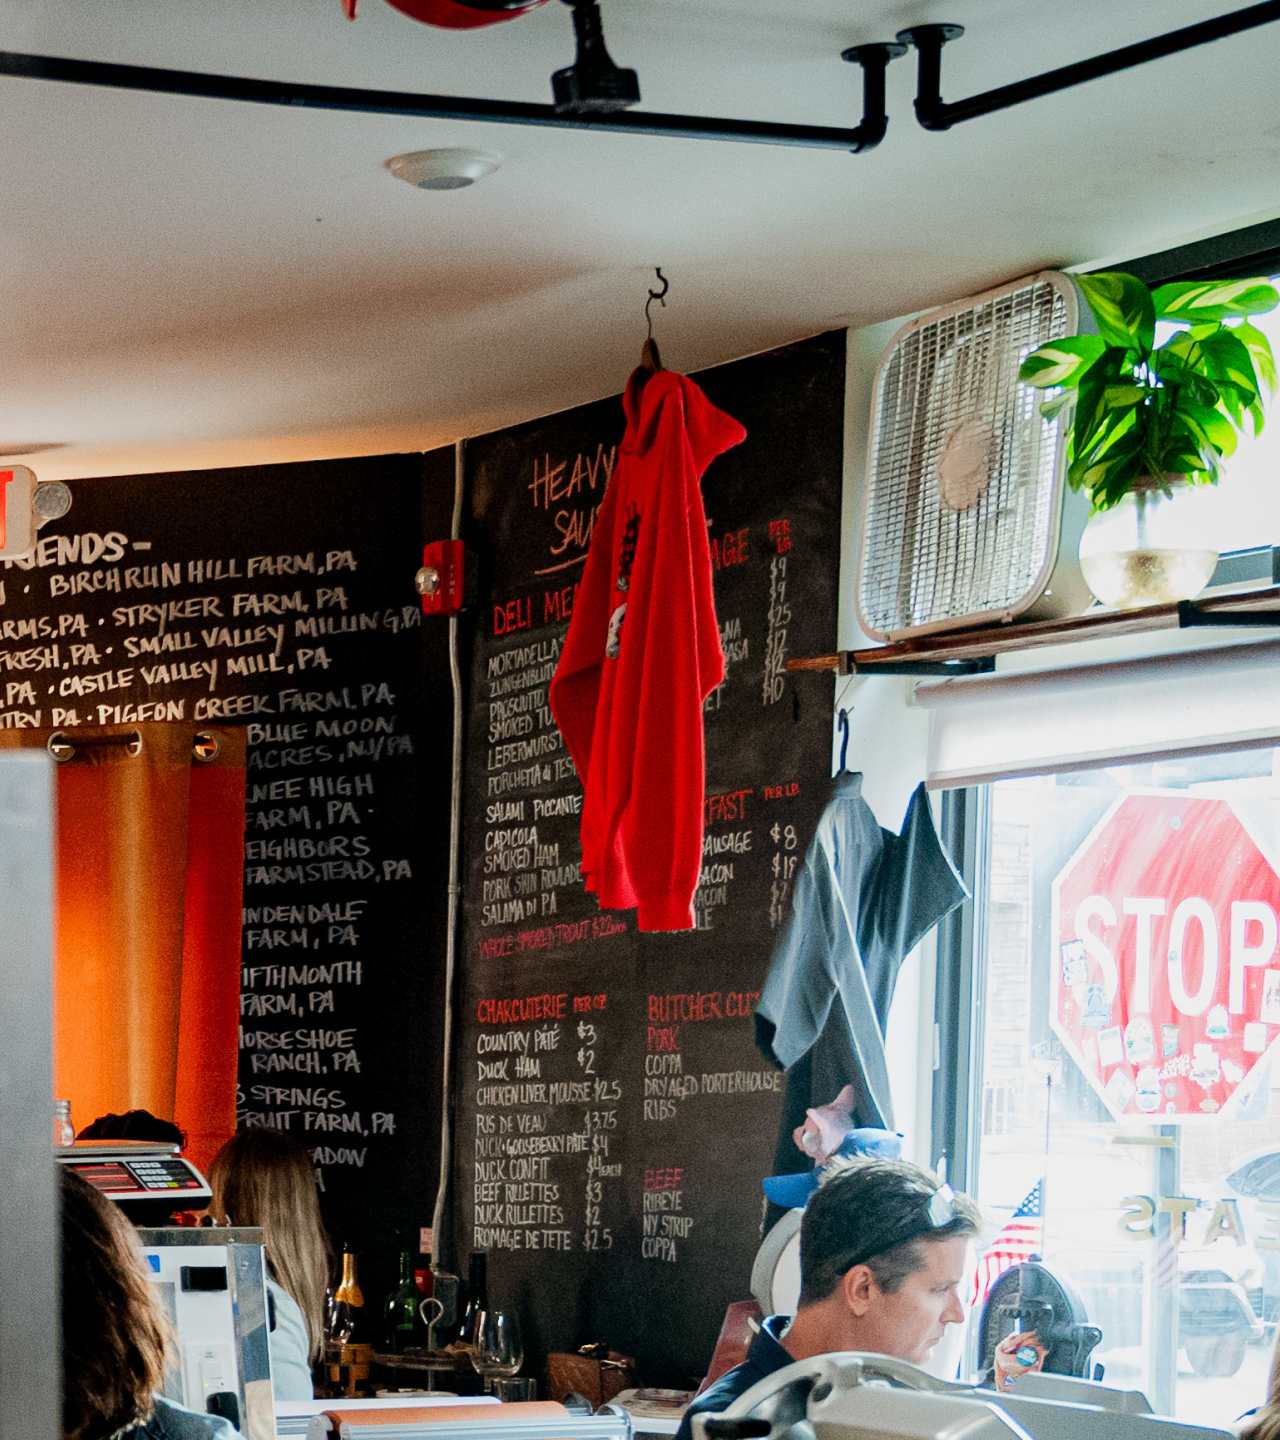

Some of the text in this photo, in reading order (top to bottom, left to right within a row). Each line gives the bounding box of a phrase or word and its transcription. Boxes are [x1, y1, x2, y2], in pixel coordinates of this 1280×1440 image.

[528, 443, 616, 510] HEAVY
[49, 567, 121, 597] BIRCH
[124, 561, 181, 588] RUN
[188, 558, 243, 583] HILL
[112, 596, 224, 637] STRYKER
[316, 587, 349, 610] PA
[494, 596, 532, 635] DELI
[58, 613, 90, 638] PA
[123, 624, 285, 659] SMALL VALLEY
[70, 643, 102, 666] PA
[488, 638, 560, 679] MORTADELLA
[59, 667, 135, 698] CASTLE
[140, 657, 218, 691] VALLEY
[296, 646, 332, 670] PA
[6, 680, 37, 706] PA
[194, 694, 276, 720] CREEK
[247, 716, 397, 745] BLUE MOON
[488, 715, 534, 743] SMOKED
[488, 730, 563, 770] LEBERWURST
[246, 773, 374, 803] NEE HIGH
[327, 800, 360, 825] PA
[485, 801, 524, 824] SALAMI
[246, 836, 371, 860] EIGHBORS
[485, 825, 538, 852] CAPICOLA
[770, 822, 798, 850] $8
[382, 859, 412, 881] PA
[483, 843, 559, 873] SMOKED HAM
[328, 924, 360, 946] PA
[1074, 896, 1278, 1017] STOP
[309, 990, 335, 1013] PA
[477, 1021, 597, 1057] COUNTRY $3
[332, 1049, 362, 1073] PA
[477, 1048, 595, 1081] DUCK HAM $2
[250, 1085, 347, 1109] SPRINGS
[476, 1084, 519, 1106] CHICKEN
[550, 1081, 591, 1105] MOUSSE
[643, 1099, 677, 1120] RIBS
[372, 1112, 397, 1135] PA
[500, 1116, 513, 1134] DE
[475, 1157, 551, 1182] DUCK CONFIT
[474, 1182, 502, 1203] BEEF
[475, 1204, 504, 1225] DUCK
[526, 1230, 540, 1249] DE
[642, 1237, 676, 1262] COPPA
